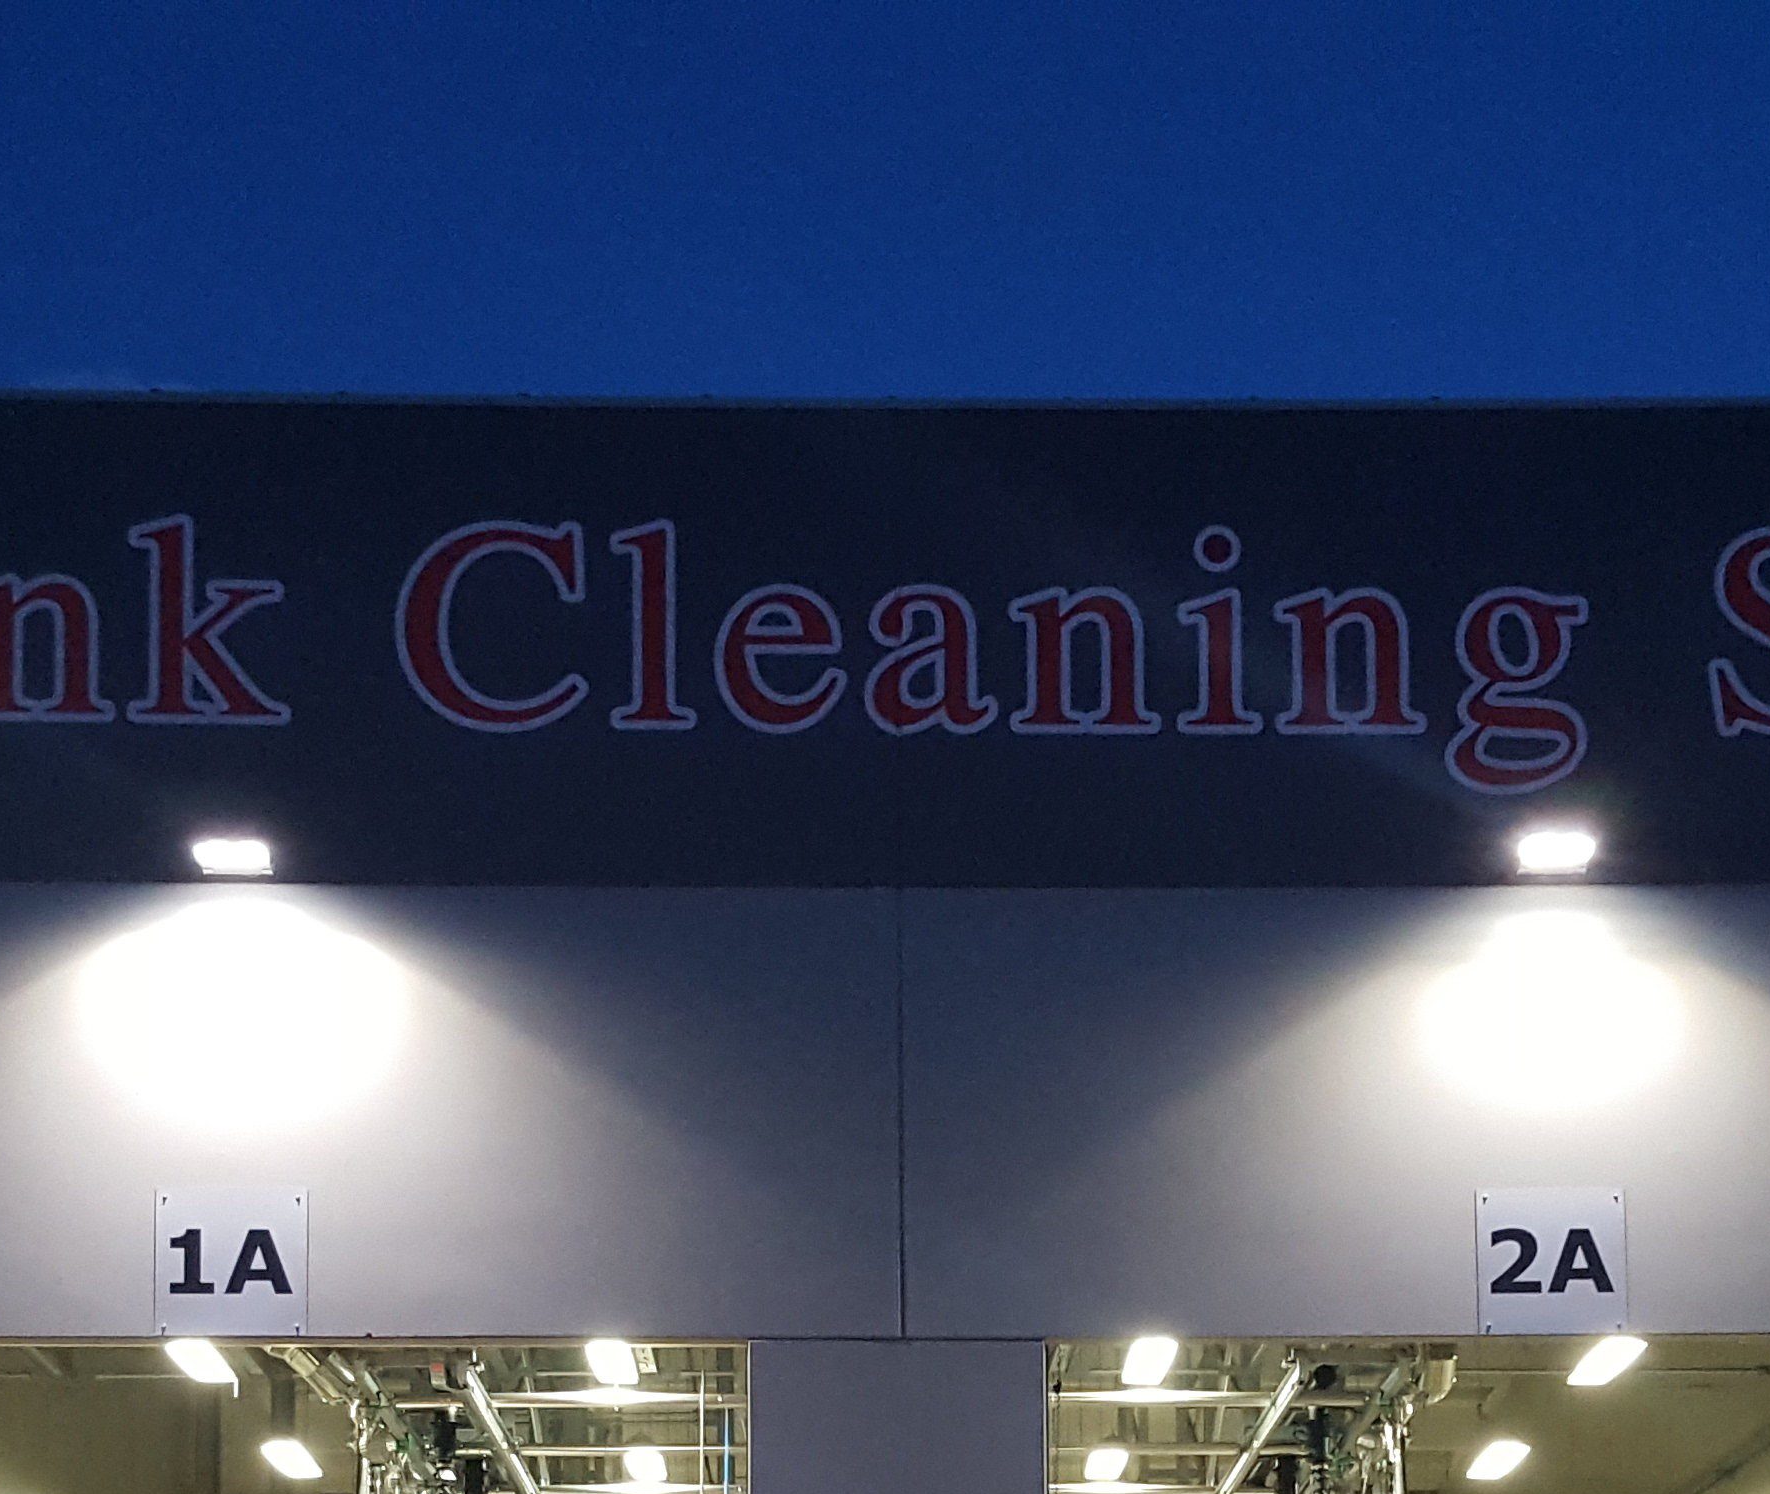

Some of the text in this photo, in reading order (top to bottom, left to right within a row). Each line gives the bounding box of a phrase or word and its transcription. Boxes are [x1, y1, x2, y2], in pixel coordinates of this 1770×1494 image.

[393, 518, 1588, 795] Cleaning
[168, 1228, 294, 1297] 1A
[1488, 1227, 1615, 1295] 2A
